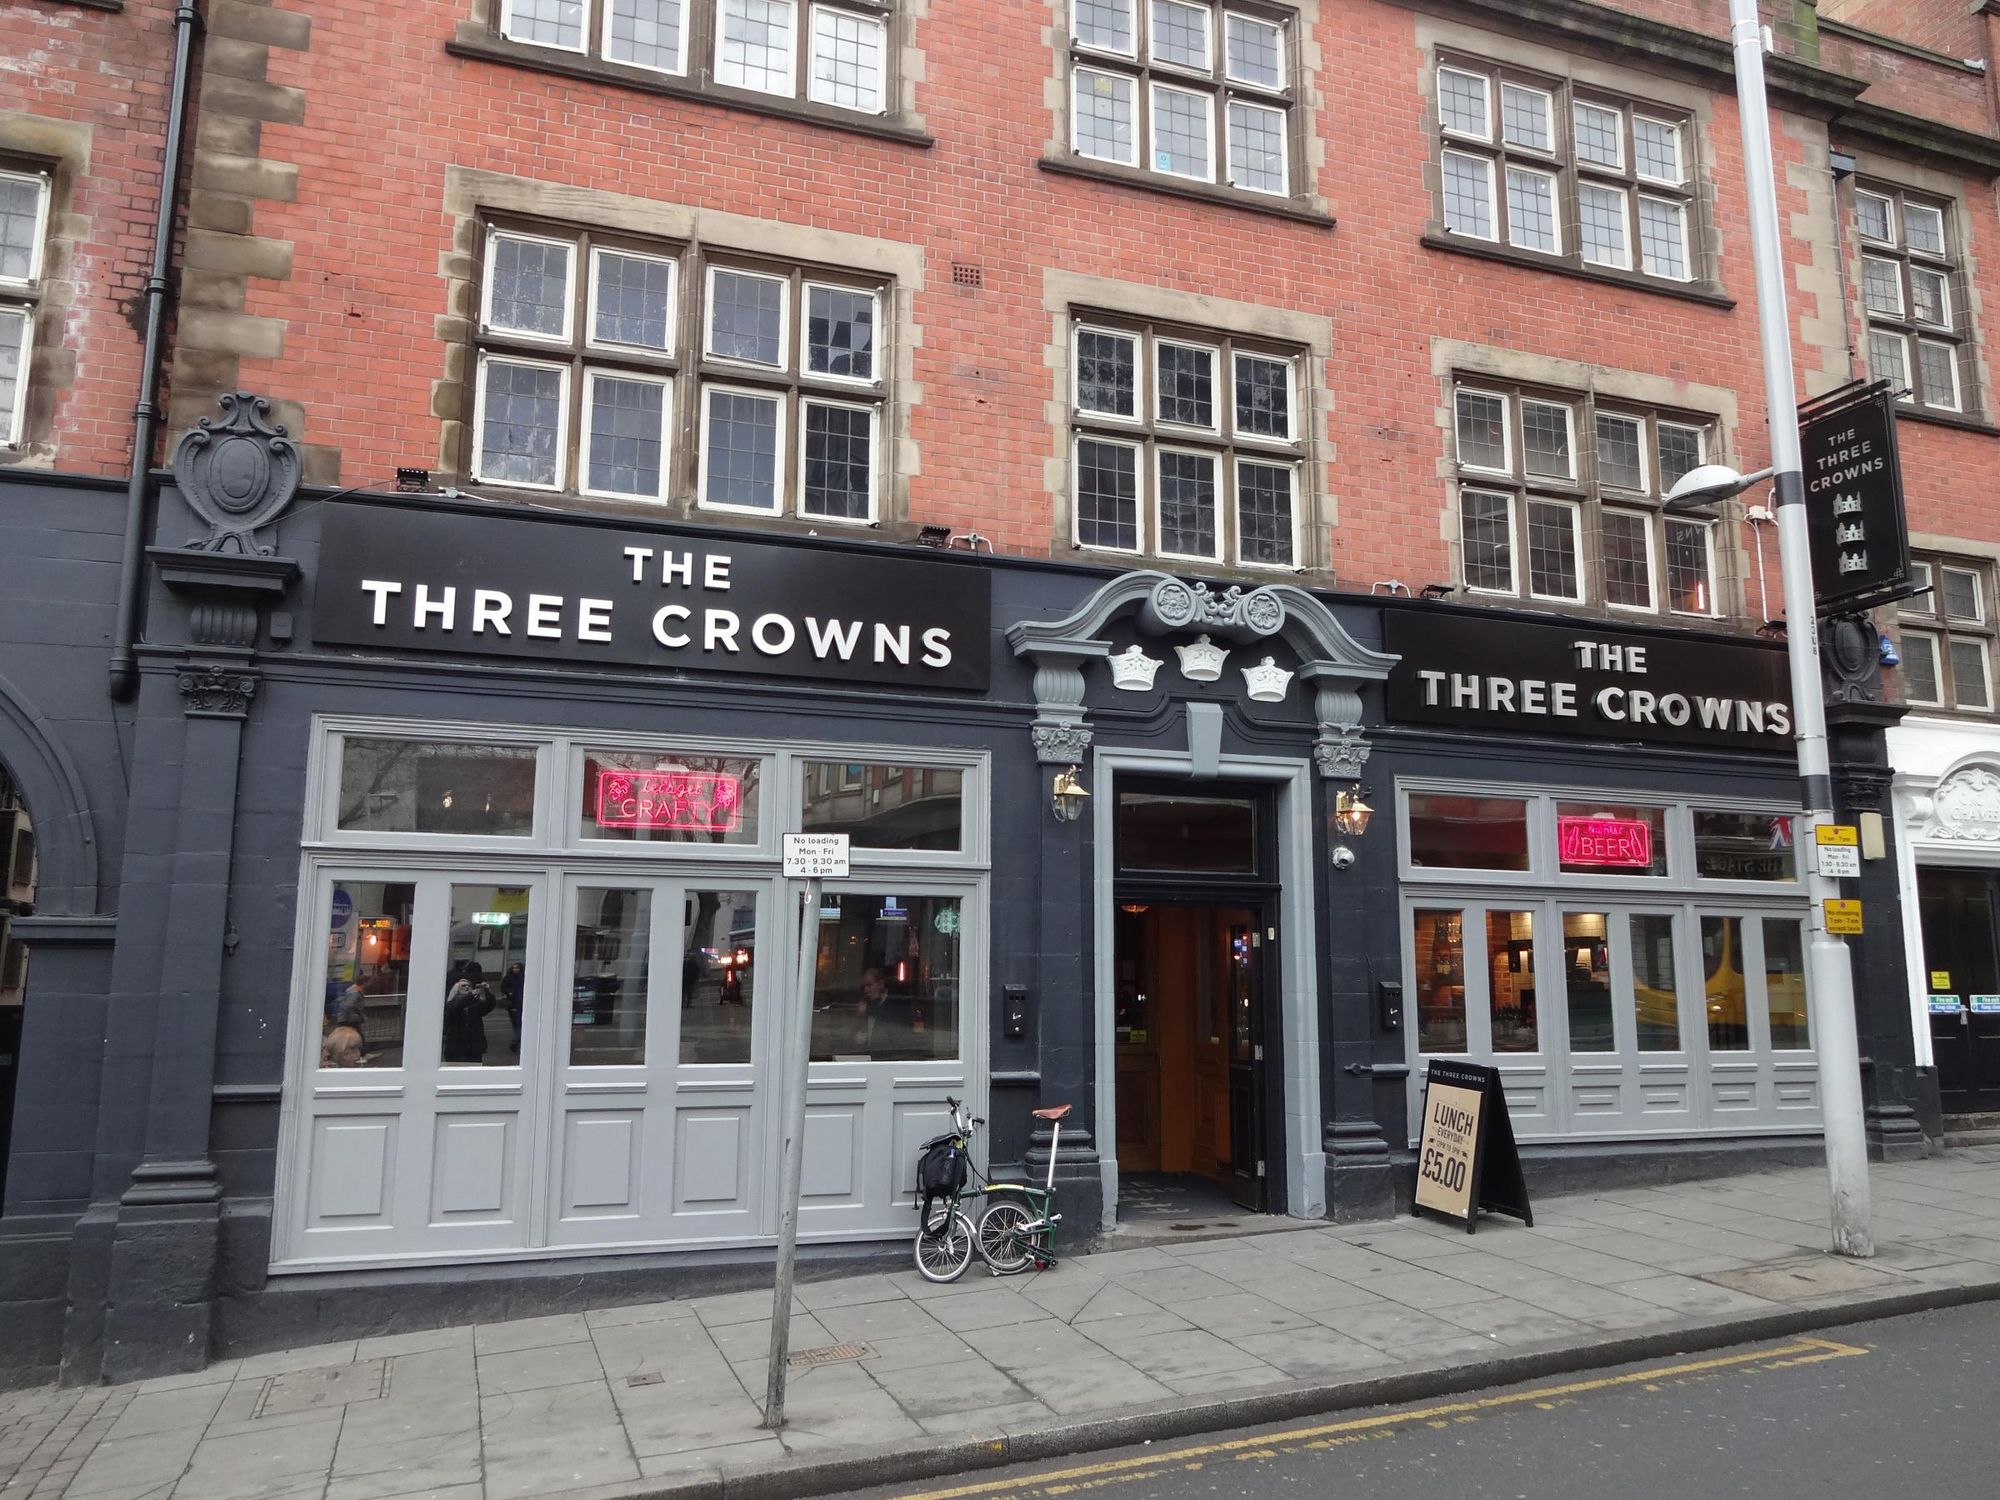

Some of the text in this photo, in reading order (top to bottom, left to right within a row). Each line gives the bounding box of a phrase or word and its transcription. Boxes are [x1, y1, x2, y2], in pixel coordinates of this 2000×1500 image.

[1828, 428, 1856, 447] THE
[1816, 440, 1872, 471] THREE
[1810, 457, 1884, 493] CROWNS
[624, 546, 732, 591] THE
[361, 579, 952, 668] THREE CROWNS
[1572, 640, 1648, 674] THE
[1416, 670, 1791, 736] THREE CROWNS
[621, 798, 720, 821] CRAFTY
[808, 837, 839, 846] loading
[1580, 837, 1632, 858] BEER
[786, 857, 806, 865] 7.30
[812, 857, 833, 865] 9.30
[800, 866, 807, 874] 4
[812, 866, 819, 874] 6
[820, 867, 833, 875] pm
[1442, 1071, 1460, 1079] THREE
[1460, 1073, 1486, 1083] CROWNS
[1433, 1102, 1474, 1137] LUNCH
[1437, 1127, 1464, 1145] EVERYDAY
[1421, 1147, 1466, 1193] £5.00
